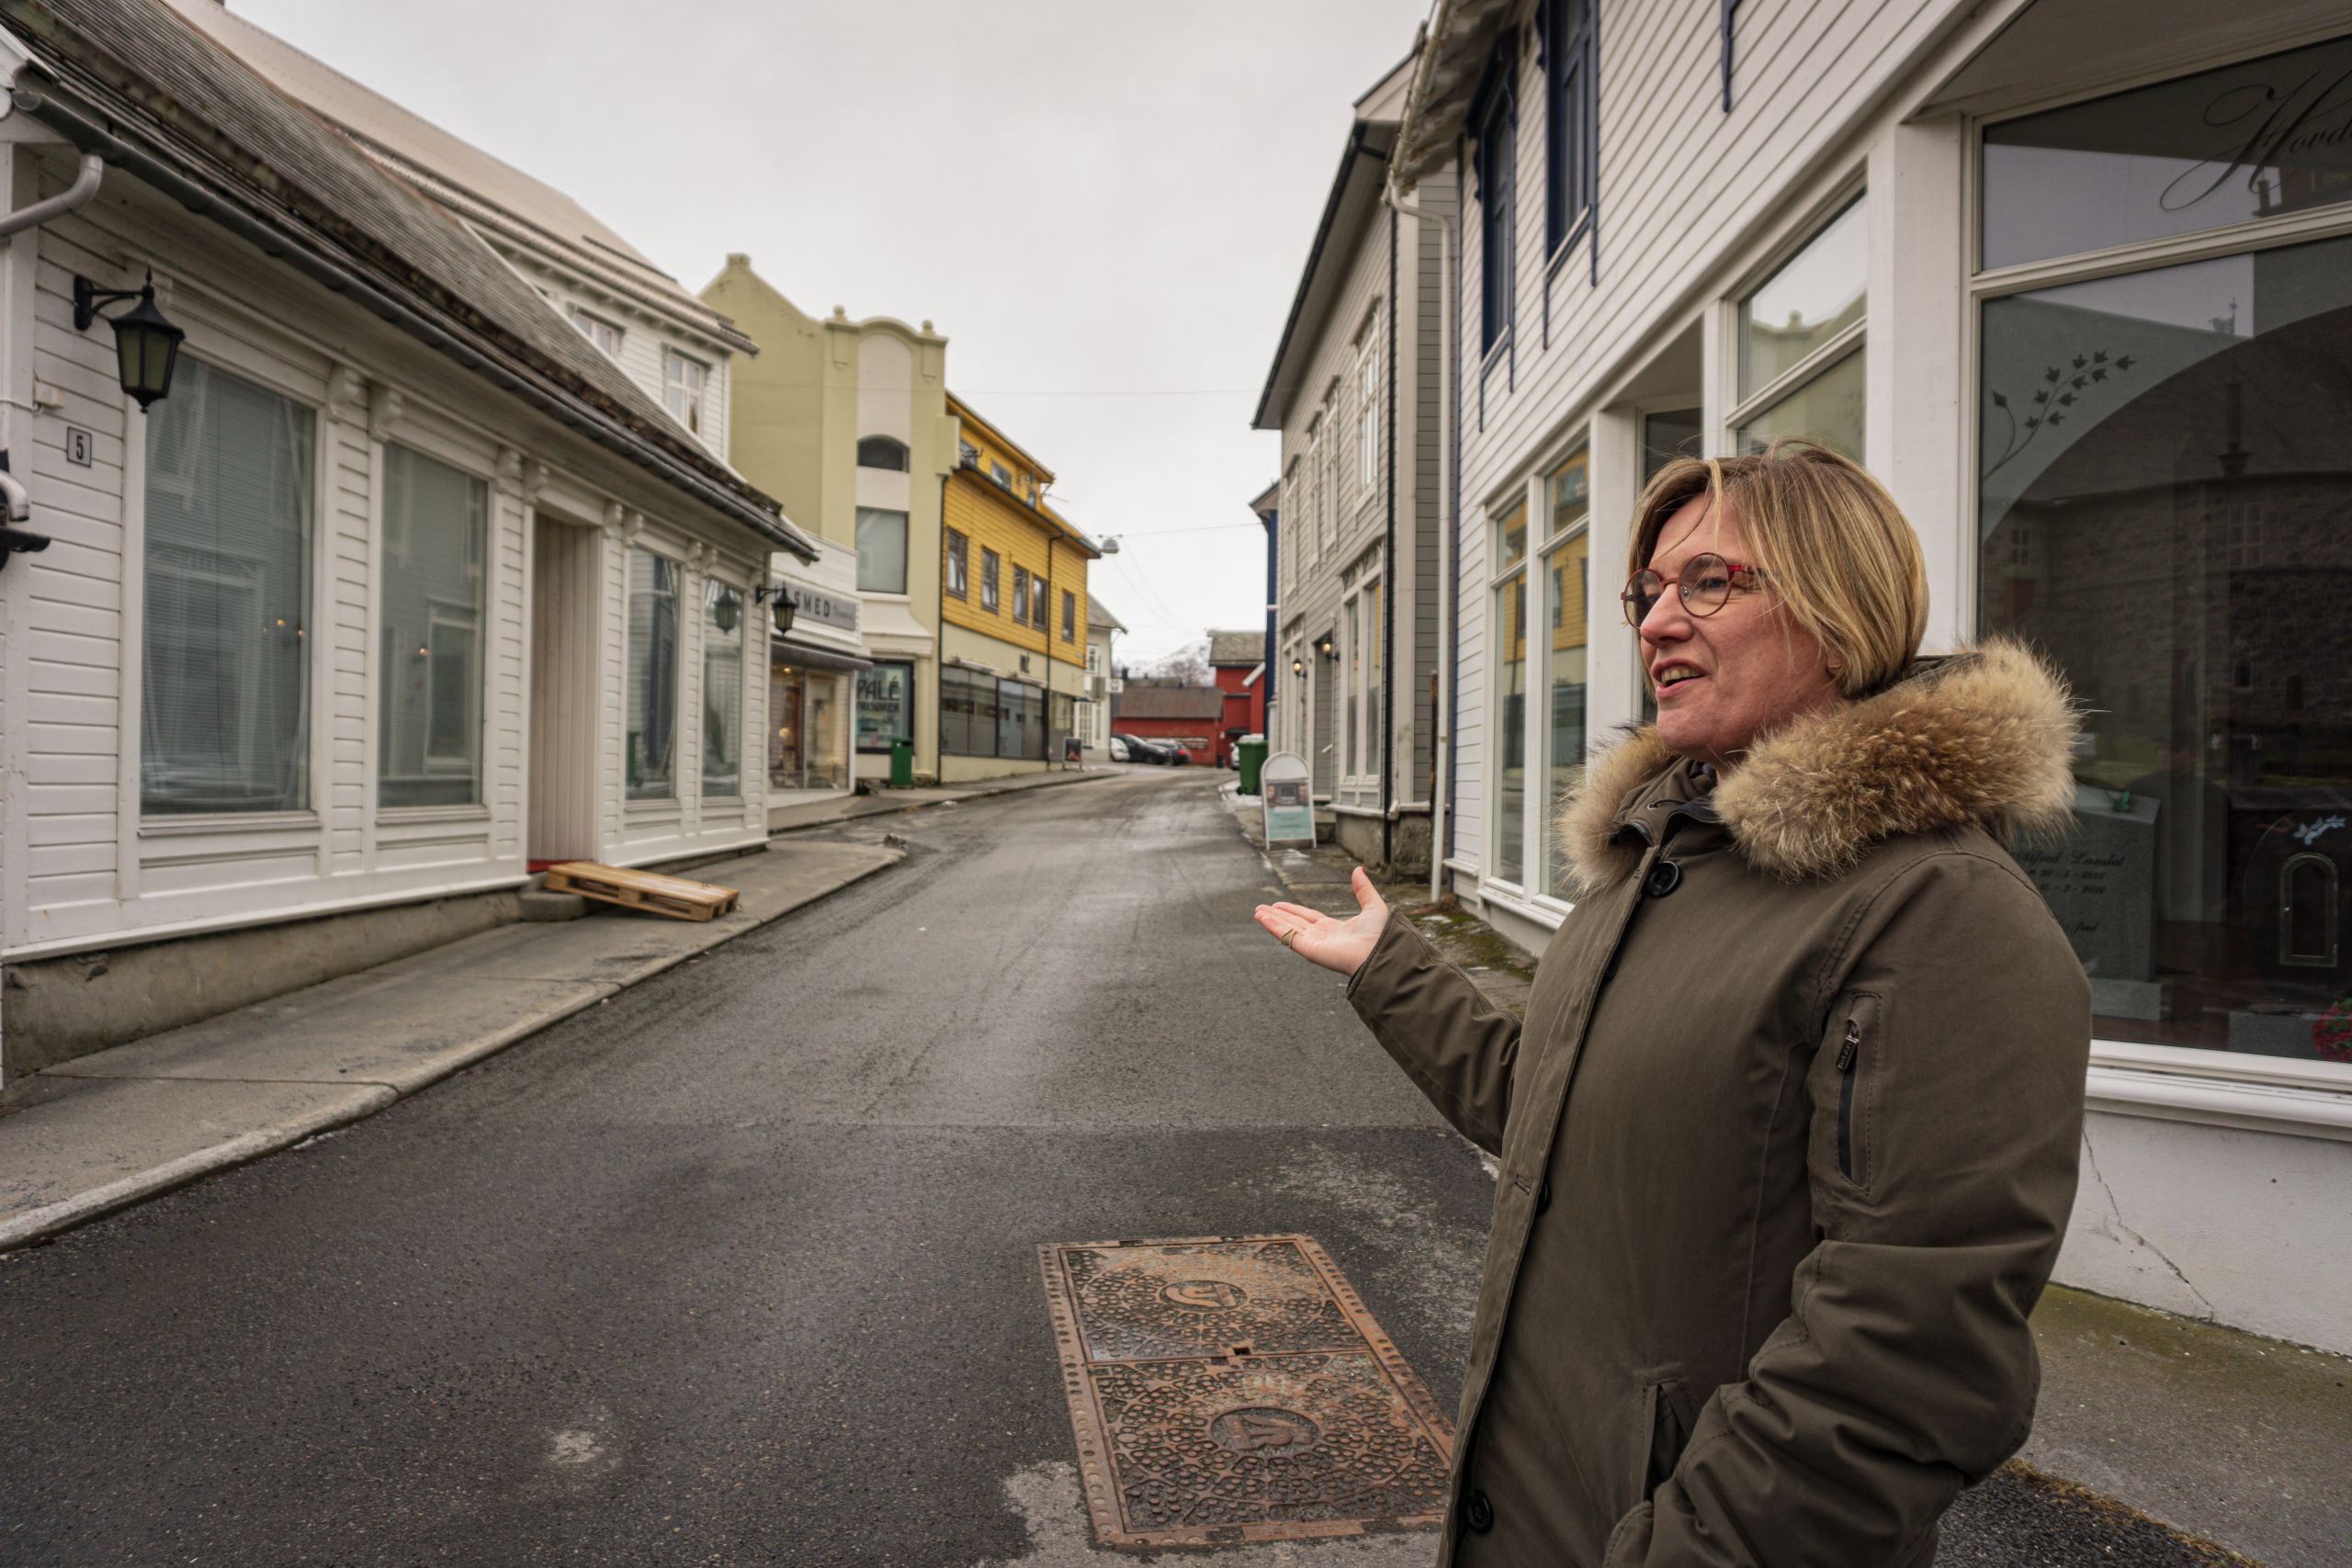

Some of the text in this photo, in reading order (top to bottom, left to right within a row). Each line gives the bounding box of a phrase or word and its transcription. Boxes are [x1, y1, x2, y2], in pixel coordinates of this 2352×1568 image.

[2159, 69, 2352, 211] Hovd
[76, 435, 85, 460] 5
[793, 591, 831, 618] SMED
[856, 675, 900, 701] PALÉ
